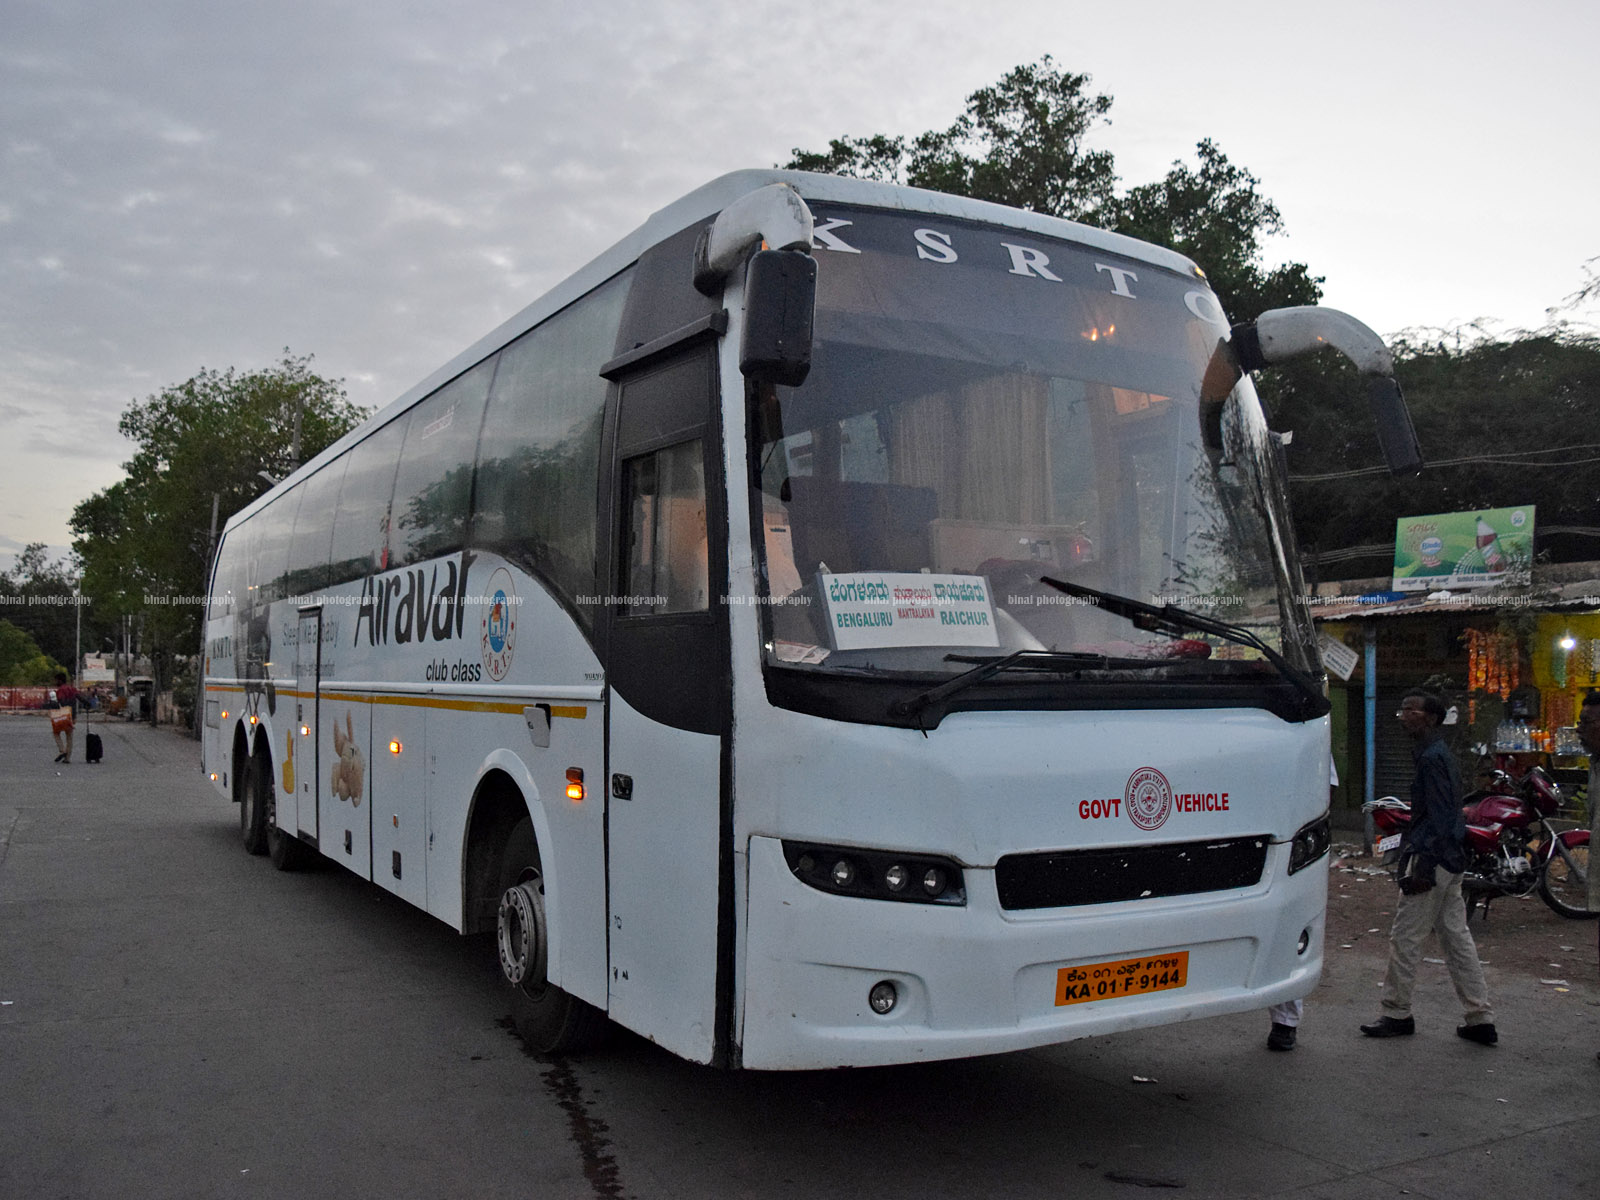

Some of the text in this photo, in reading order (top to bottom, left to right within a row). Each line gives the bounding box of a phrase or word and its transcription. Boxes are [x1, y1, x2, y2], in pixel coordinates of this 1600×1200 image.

[836, 611, 893, 628] BENGALURU
[940, 611, 990, 626] RAICHUR
[426, 658, 482, 683] club class
[1078, 793, 1230, 820] GOVT VEHICLE
